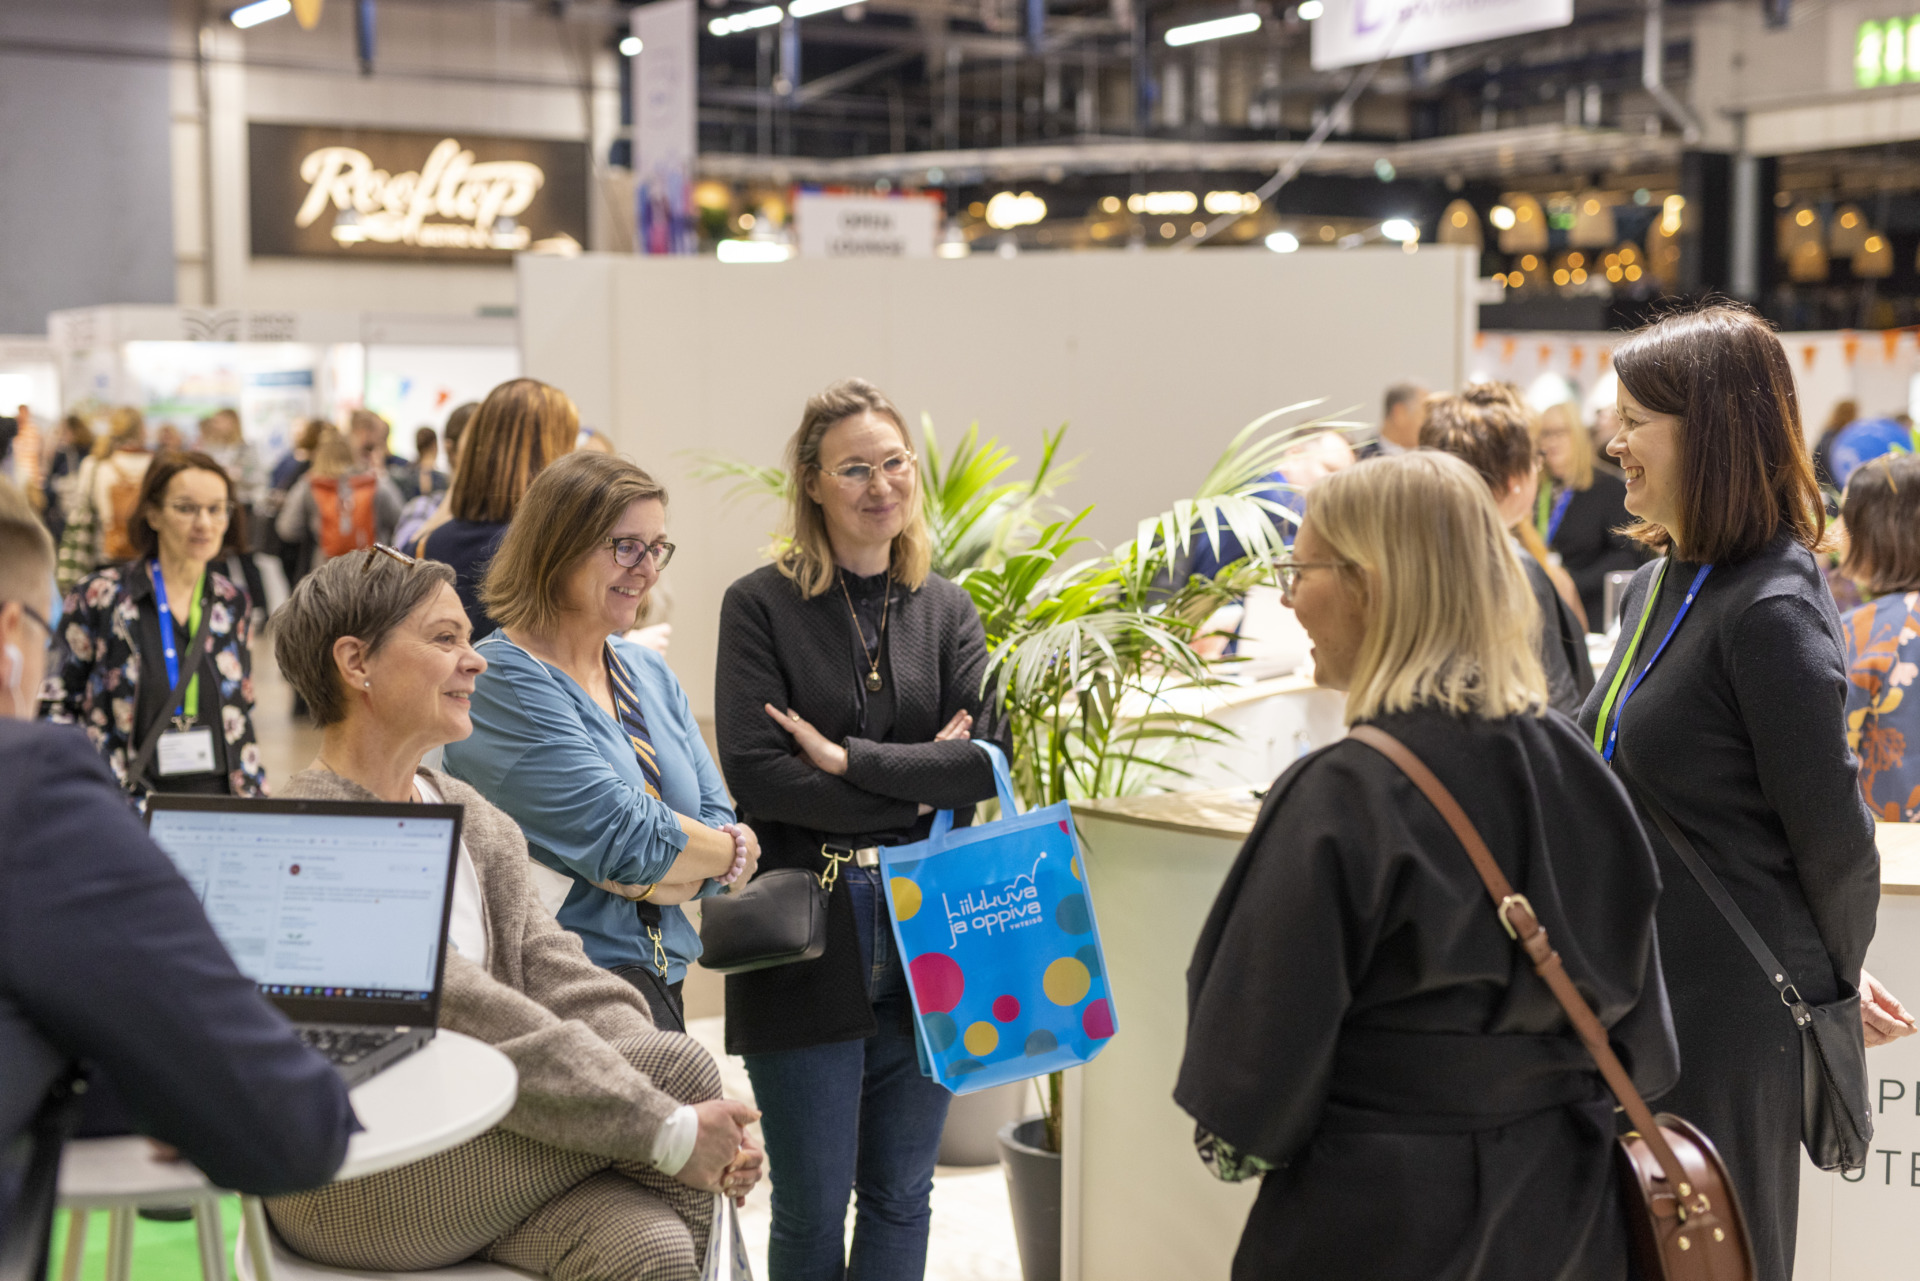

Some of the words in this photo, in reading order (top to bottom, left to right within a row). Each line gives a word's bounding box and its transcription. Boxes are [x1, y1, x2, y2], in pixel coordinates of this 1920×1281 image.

[295, 138, 546, 232] Rooftop
[942, 886, 1038, 919] Liikkuva
[948, 920, 968, 950] ja
[972, 901, 1041, 936] oppiva
[1009, 915, 1043, 930] YHTEISÖ
[1878, 1078, 1920, 1116] P
